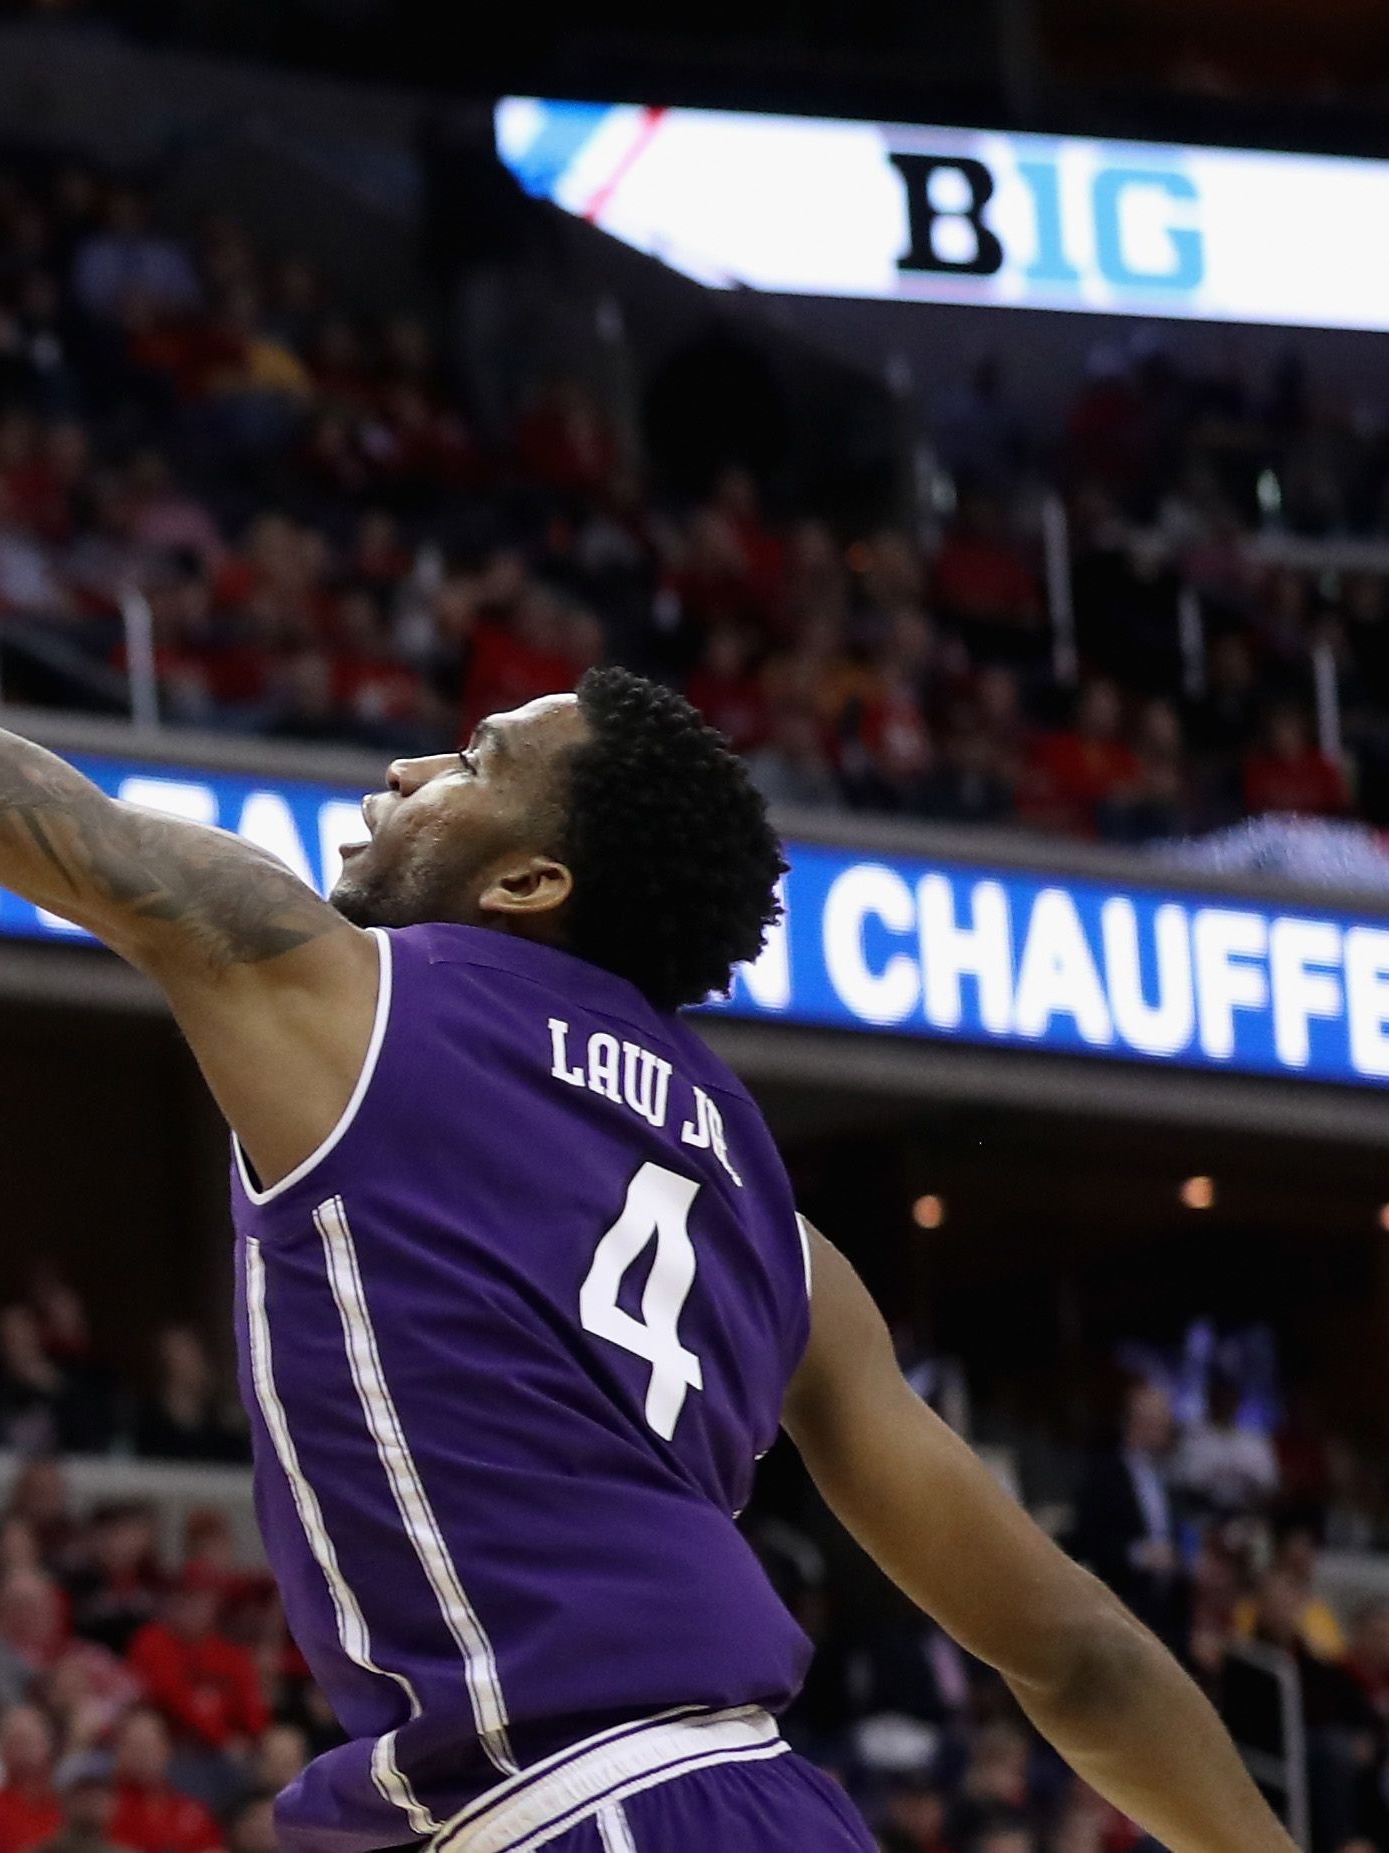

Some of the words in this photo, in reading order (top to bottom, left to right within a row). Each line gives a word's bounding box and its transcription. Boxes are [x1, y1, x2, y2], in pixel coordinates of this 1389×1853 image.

[548, 1018, 673, 1127] LAW
[822, 863, 1389, 1078] CHAUFFE
[579, 1161, 704, 1443] 4
